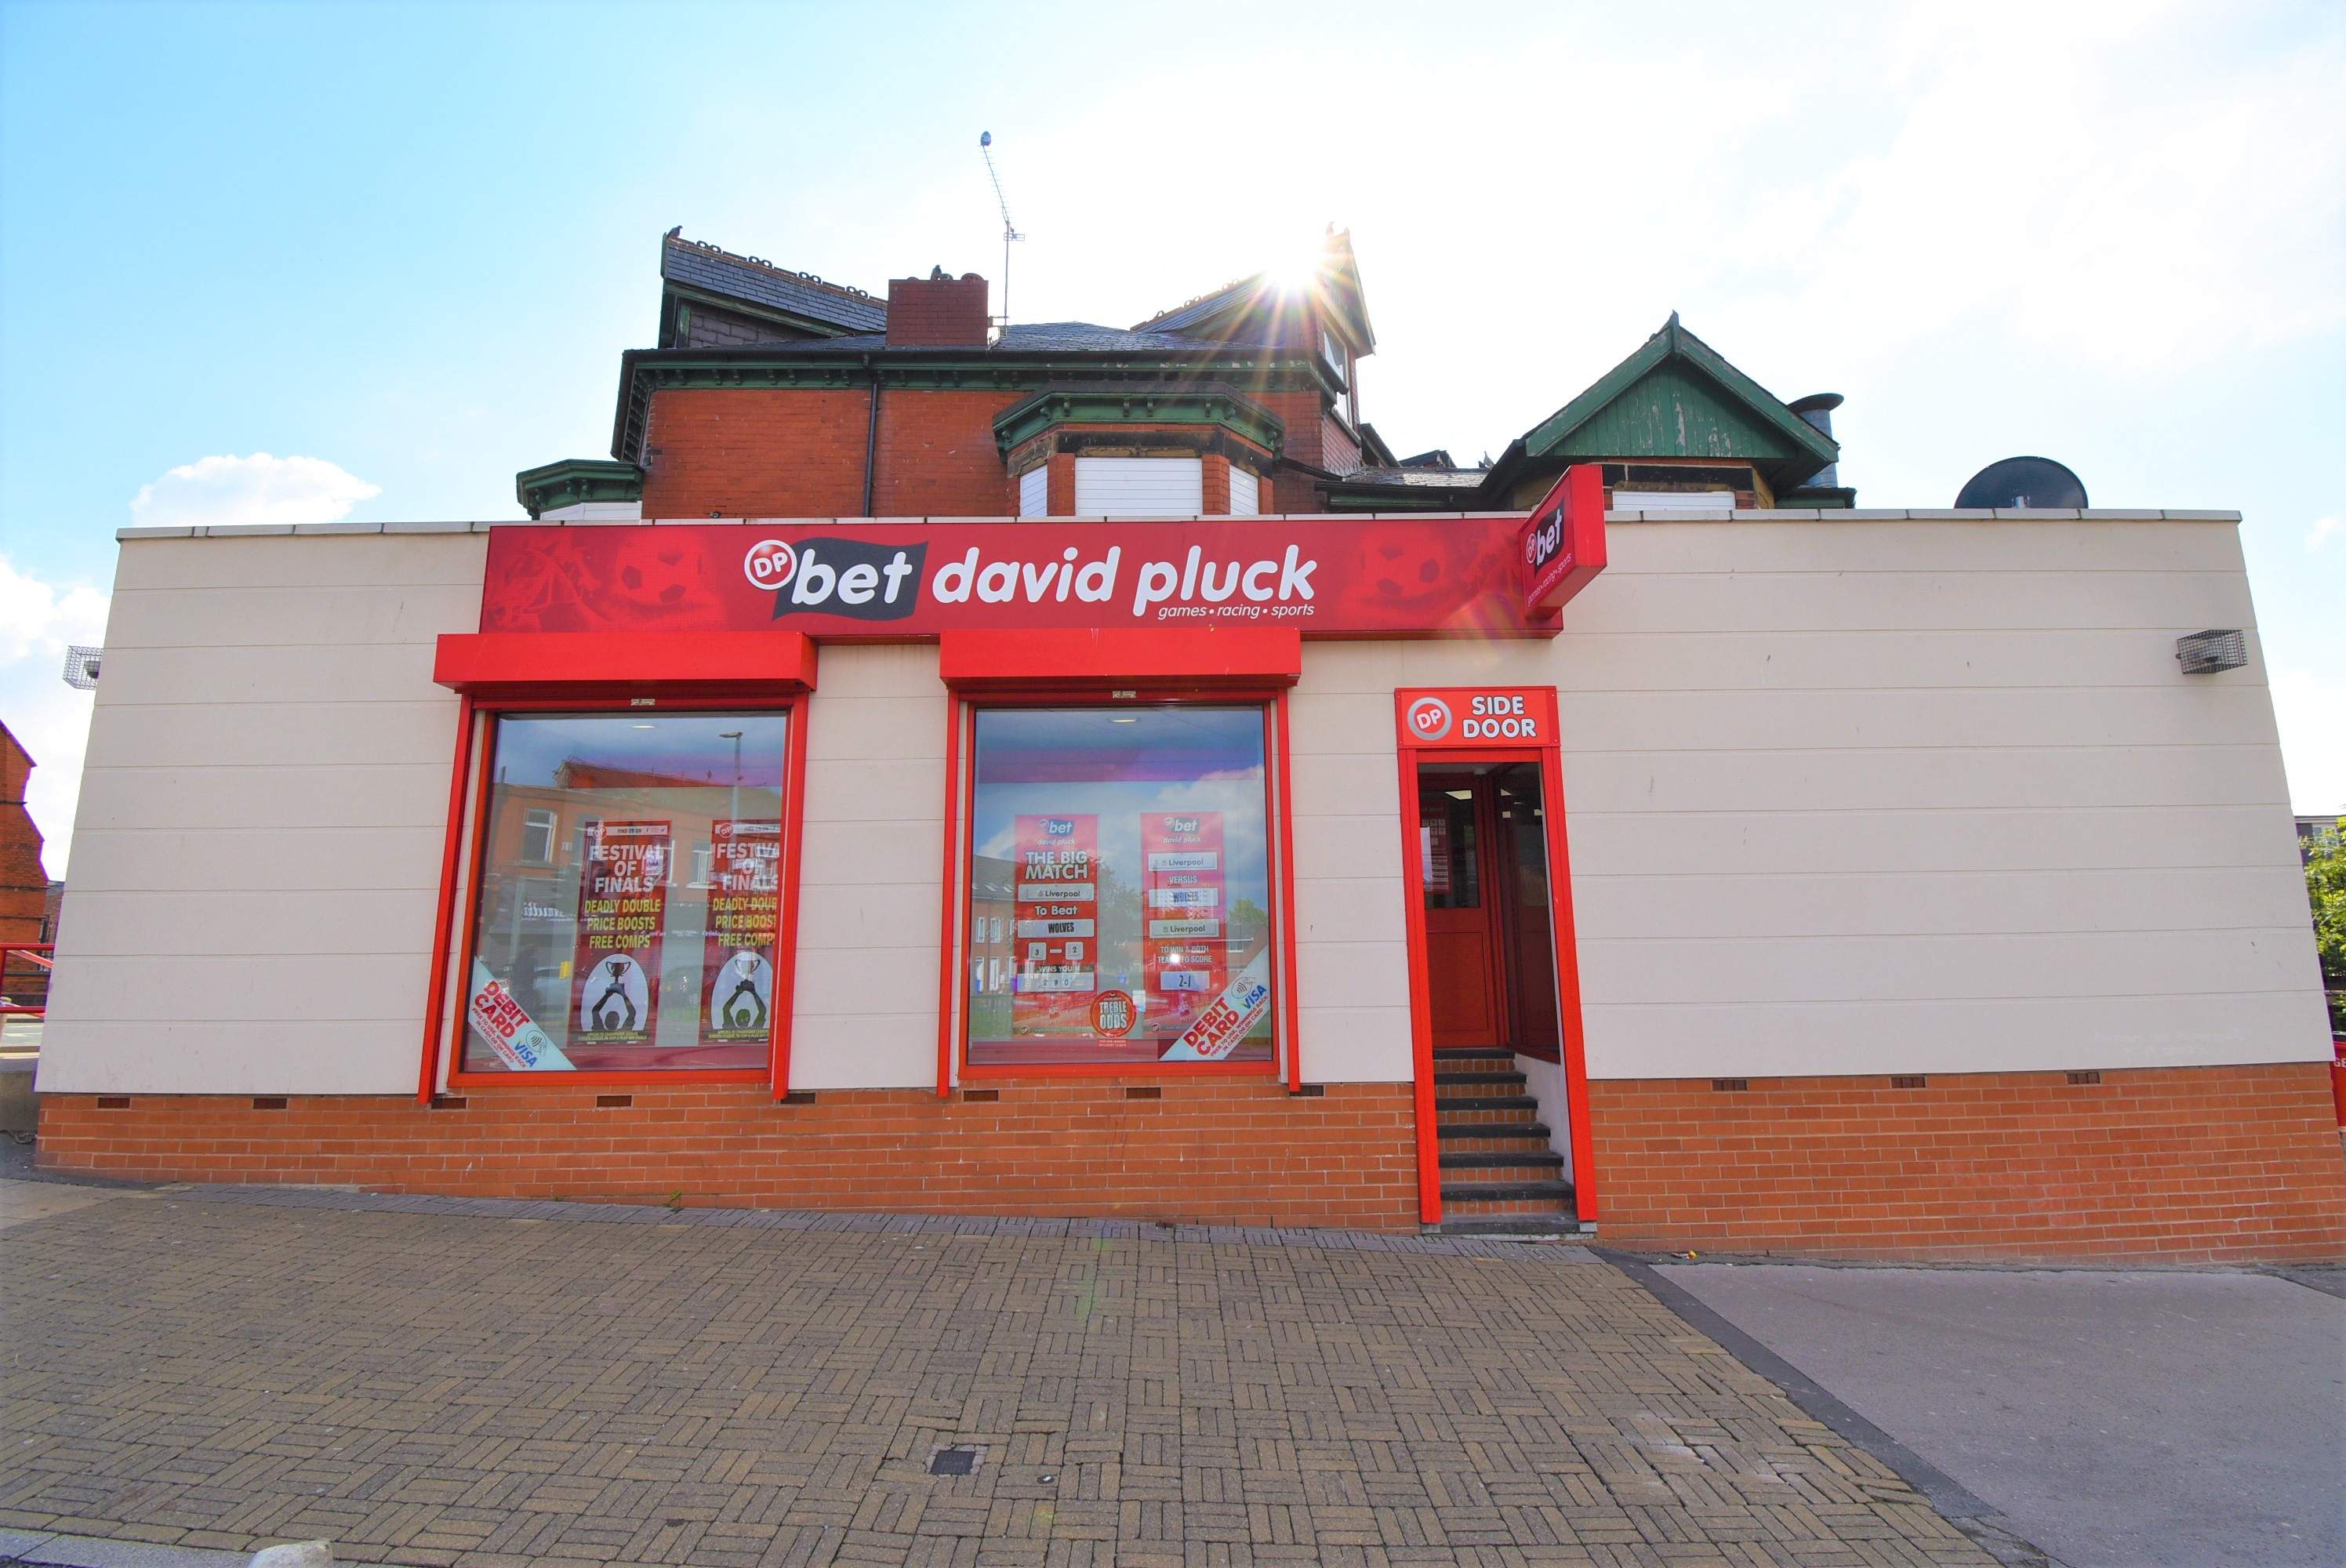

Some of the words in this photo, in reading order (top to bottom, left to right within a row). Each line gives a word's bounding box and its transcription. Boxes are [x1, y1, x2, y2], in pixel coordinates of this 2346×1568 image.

[1528, 539, 1535, 558] DP
[1537, 509, 1562, 565] bet
[754, 552, 788, 578] DP
[791, 549, 913, 605] bet
[932, 546, 1121, 604] david
[1133, 544, 1317, 617] pluck
[1157, 605, 1207, 620] games
[1217, 604, 1260, 619] racing
[1271, 603, 1315, 618] sports
[1471, 695, 1525, 716] SIDE
[1416, 709, 1443, 729] DP
[1462, 718, 1537, 739] DOOR
[1049, 821, 1073, 833] bet
[1175, 819, 1197, 831] bet
[590, 844, 664, 861] FESTIVAL
[1026, 851, 1055, 864] THE
[1060, 851, 1088, 864] BIG
[614, 860, 637, 877] OF
[1025, 864, 1088, 879] MATCH
[595, 877, 654, 892] FINALS
[1168, 875, 1198, 884] VERSUS
[584, 899, 620, 913] DEADLY
[623, 899, 661, 913] DOUBLE
[713, 897, 748, 911] DEADLY
[1035, 906, 1048, 916] To
[1051, 905, 1077, 916] Beat
[586, 917, 616, 931] PRICE
[617, 916, 656, 931] BOOSTS
[716, 915, 743, 928] PRICE
[1048, 922, 1074, 934] WOLVES
[590, 935, 613, 949] FREE
[616, 935, 651, 948] COMPS
[718, 933, 742, 946] FREE
[1178, 975, 1191, 988] 2-1
[484, 980, 530, 1028] DEBIT
[1244, 985, 1267, 1009] VISA
[1099, 1000, 1127, 1013] TREBLE
[474, 993, 515, 1037] CARD
[1099, 1014, 1127, 1029] ODDS
[1183, 996, 1229, 1047] DEBIT
[480, 1025, 492, 1039] CASH
[1197, 1011, 1239, 1055] CARD
[1228, 1033, 1239, 1046] CASH
[514, 1041, 538, 1067] VISA
